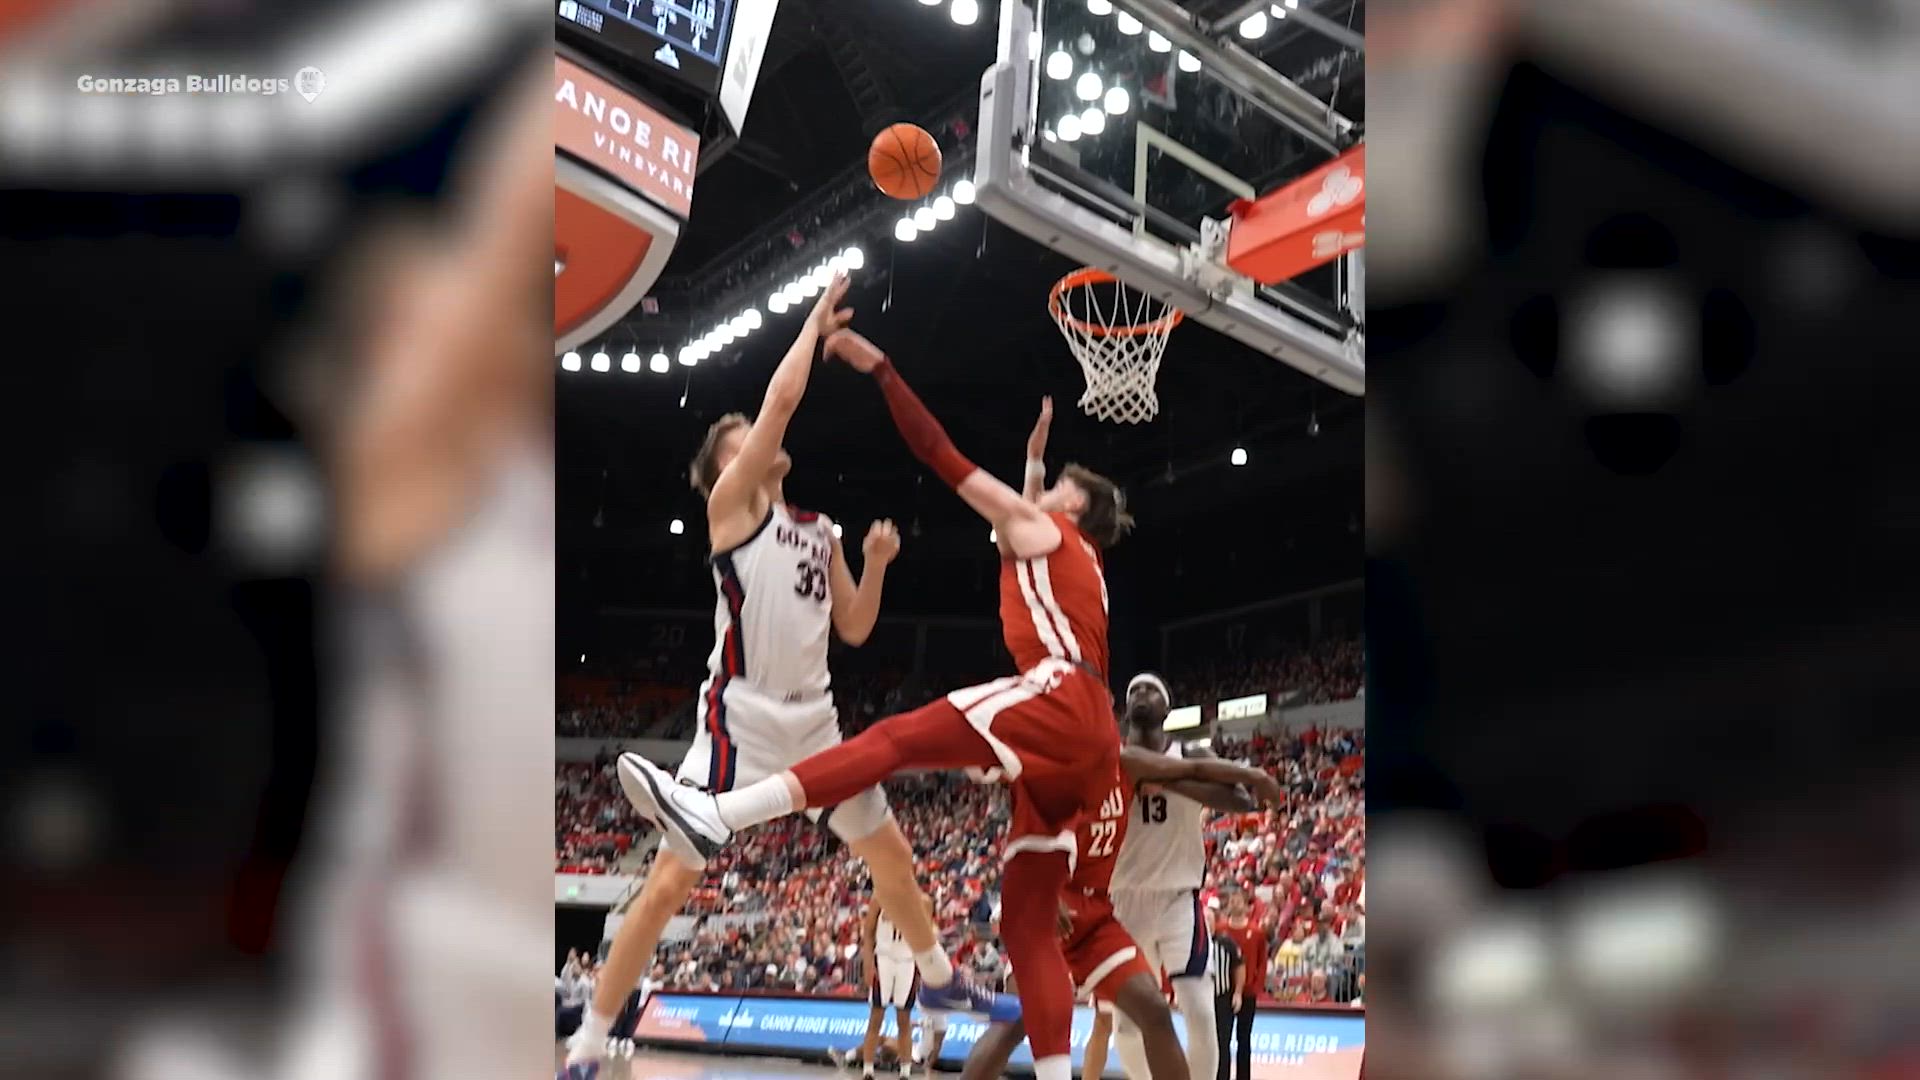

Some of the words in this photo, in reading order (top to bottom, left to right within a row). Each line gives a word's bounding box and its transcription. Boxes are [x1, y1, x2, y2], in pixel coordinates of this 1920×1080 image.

[555, 79, 651, 149] ANOE
[795, 560, 826, 602] 33
[1141, 793, 1168, 825] 13
[1087, 820, 1117, 857] 22
[829, 1018, 870, 1036] VINEYA
